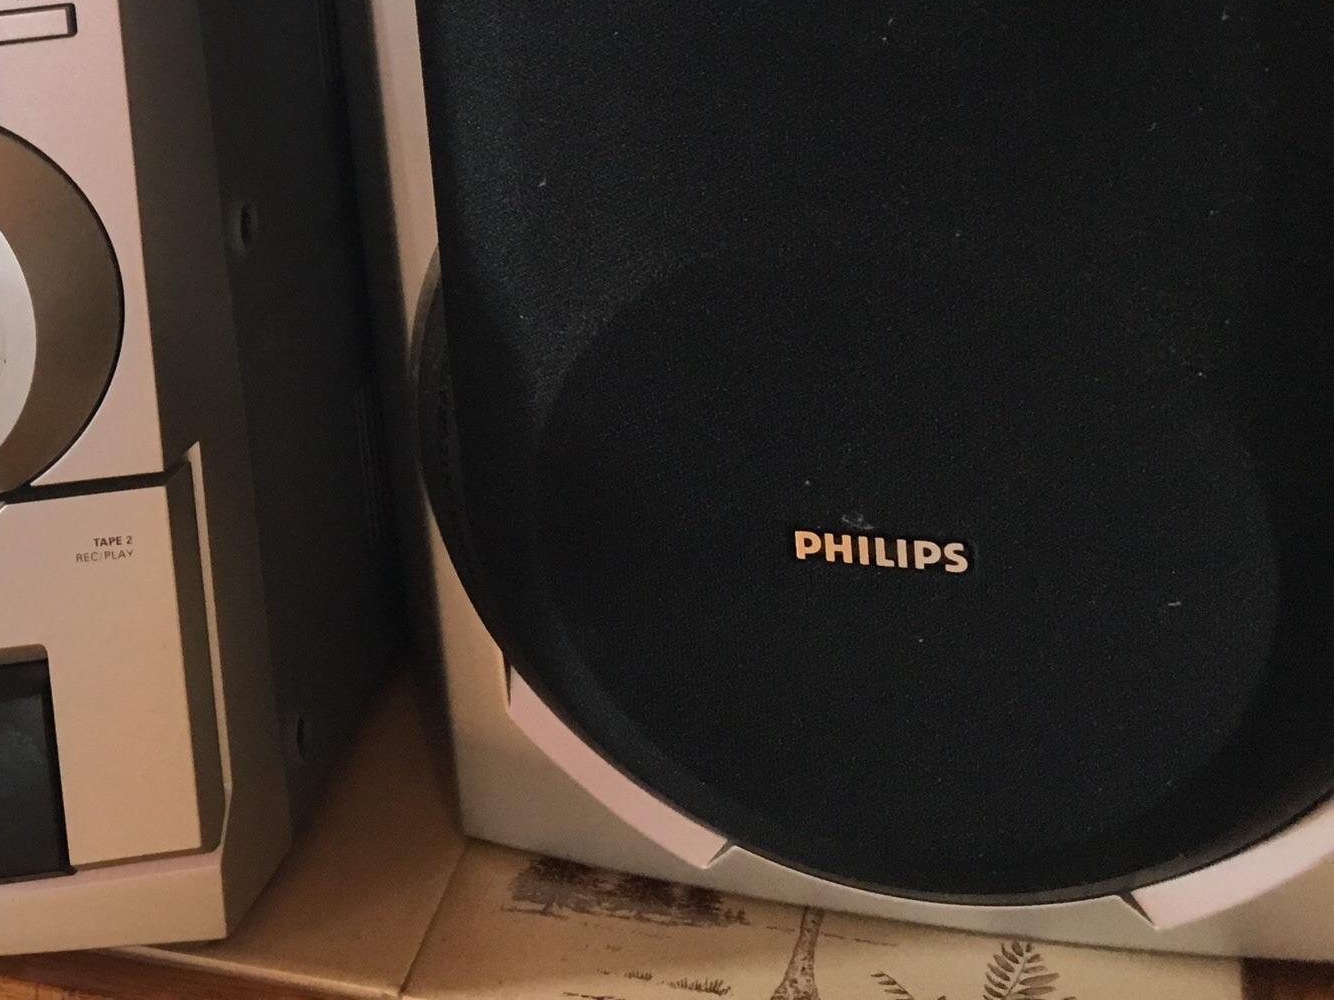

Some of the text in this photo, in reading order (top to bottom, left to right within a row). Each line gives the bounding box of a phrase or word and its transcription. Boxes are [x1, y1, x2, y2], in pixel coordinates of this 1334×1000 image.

[93, 535, 134, 547] TAPE 2
[794, 530, 969, 574] PHILIPS
